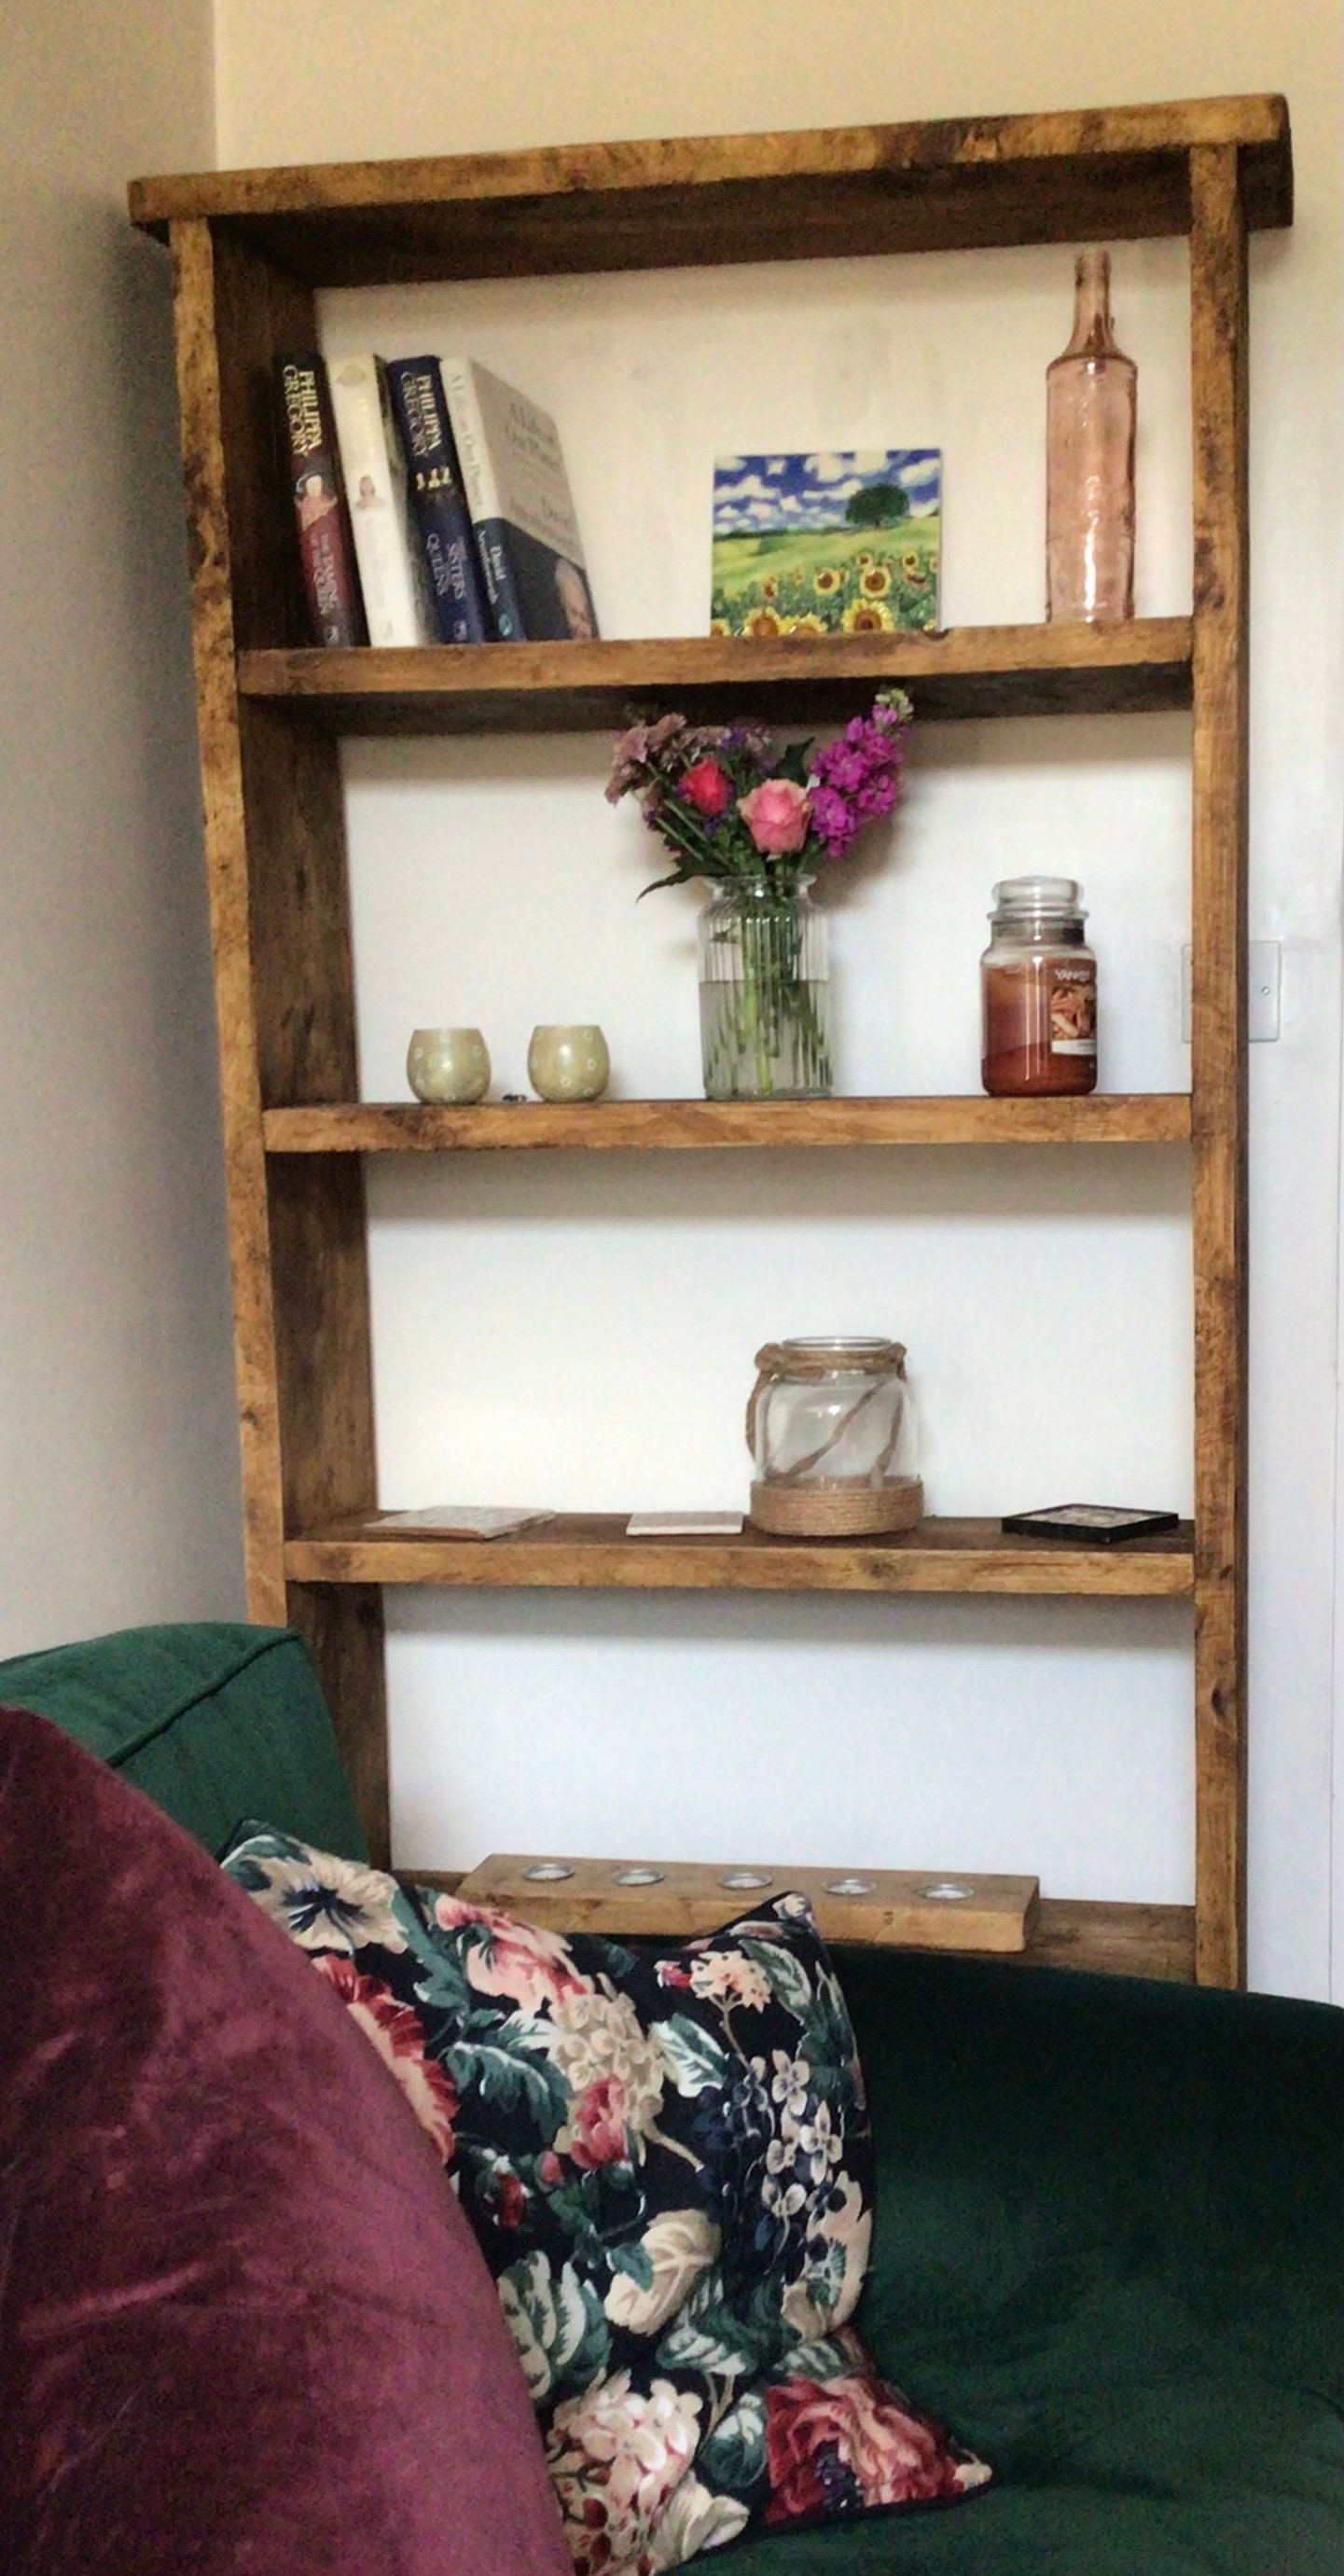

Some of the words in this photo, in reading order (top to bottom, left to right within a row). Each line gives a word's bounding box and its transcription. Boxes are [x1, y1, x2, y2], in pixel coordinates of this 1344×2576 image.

[283, 364, 309, 457] GREGORY
[298, 370, 323, 450] PHILIPPA
[401, 371, 429, 457] GREGORY
[416, 374, 442, 450] PHILIPPA
